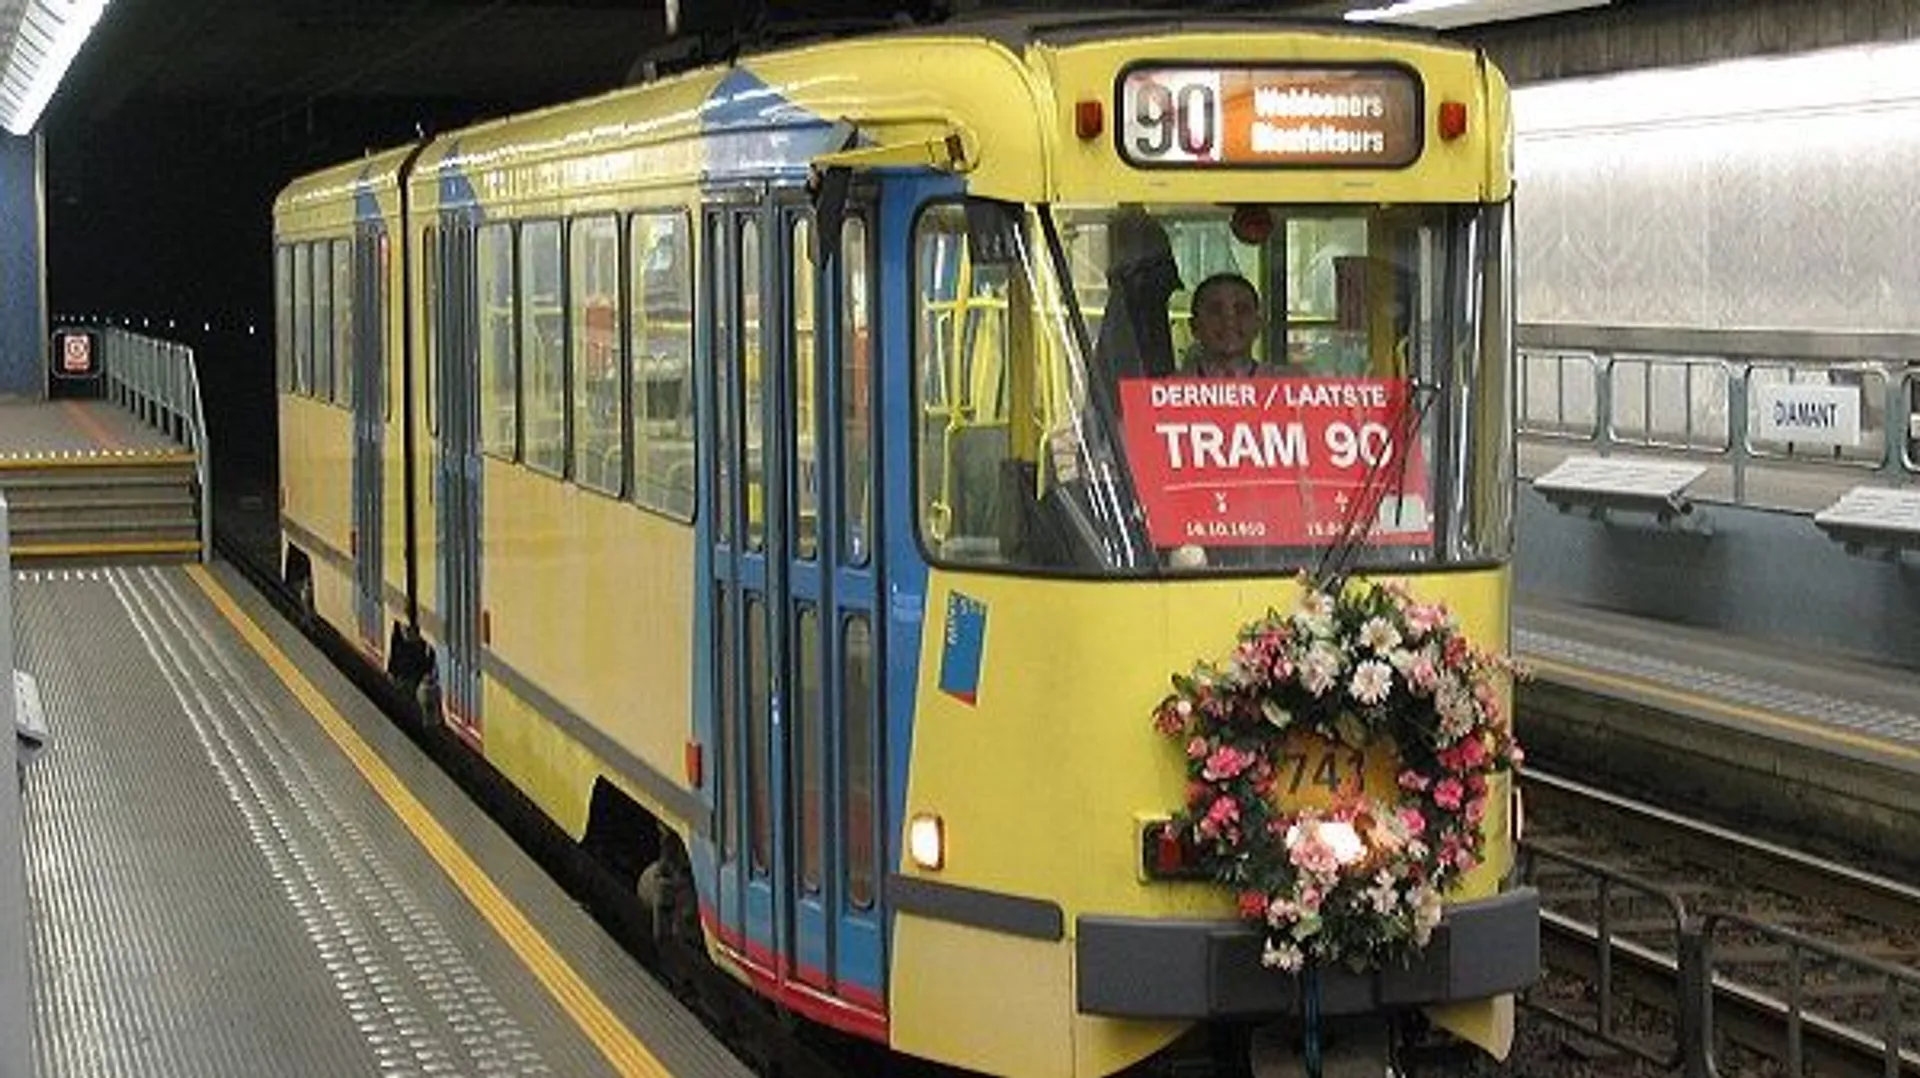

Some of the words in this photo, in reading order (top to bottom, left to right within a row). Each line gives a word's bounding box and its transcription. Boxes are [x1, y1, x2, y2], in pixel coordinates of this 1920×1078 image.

[1135, 83, 1214, 156] 90
[1151, 384, 1256, 407] DERNIER
[1286, 384, 1388, 407] LAATSTE
[1774, 400, 1837, 428] DIAMANT
[1155, 422, 1310, 469] TRAM
[1324, 422, 1394, 469] 90
